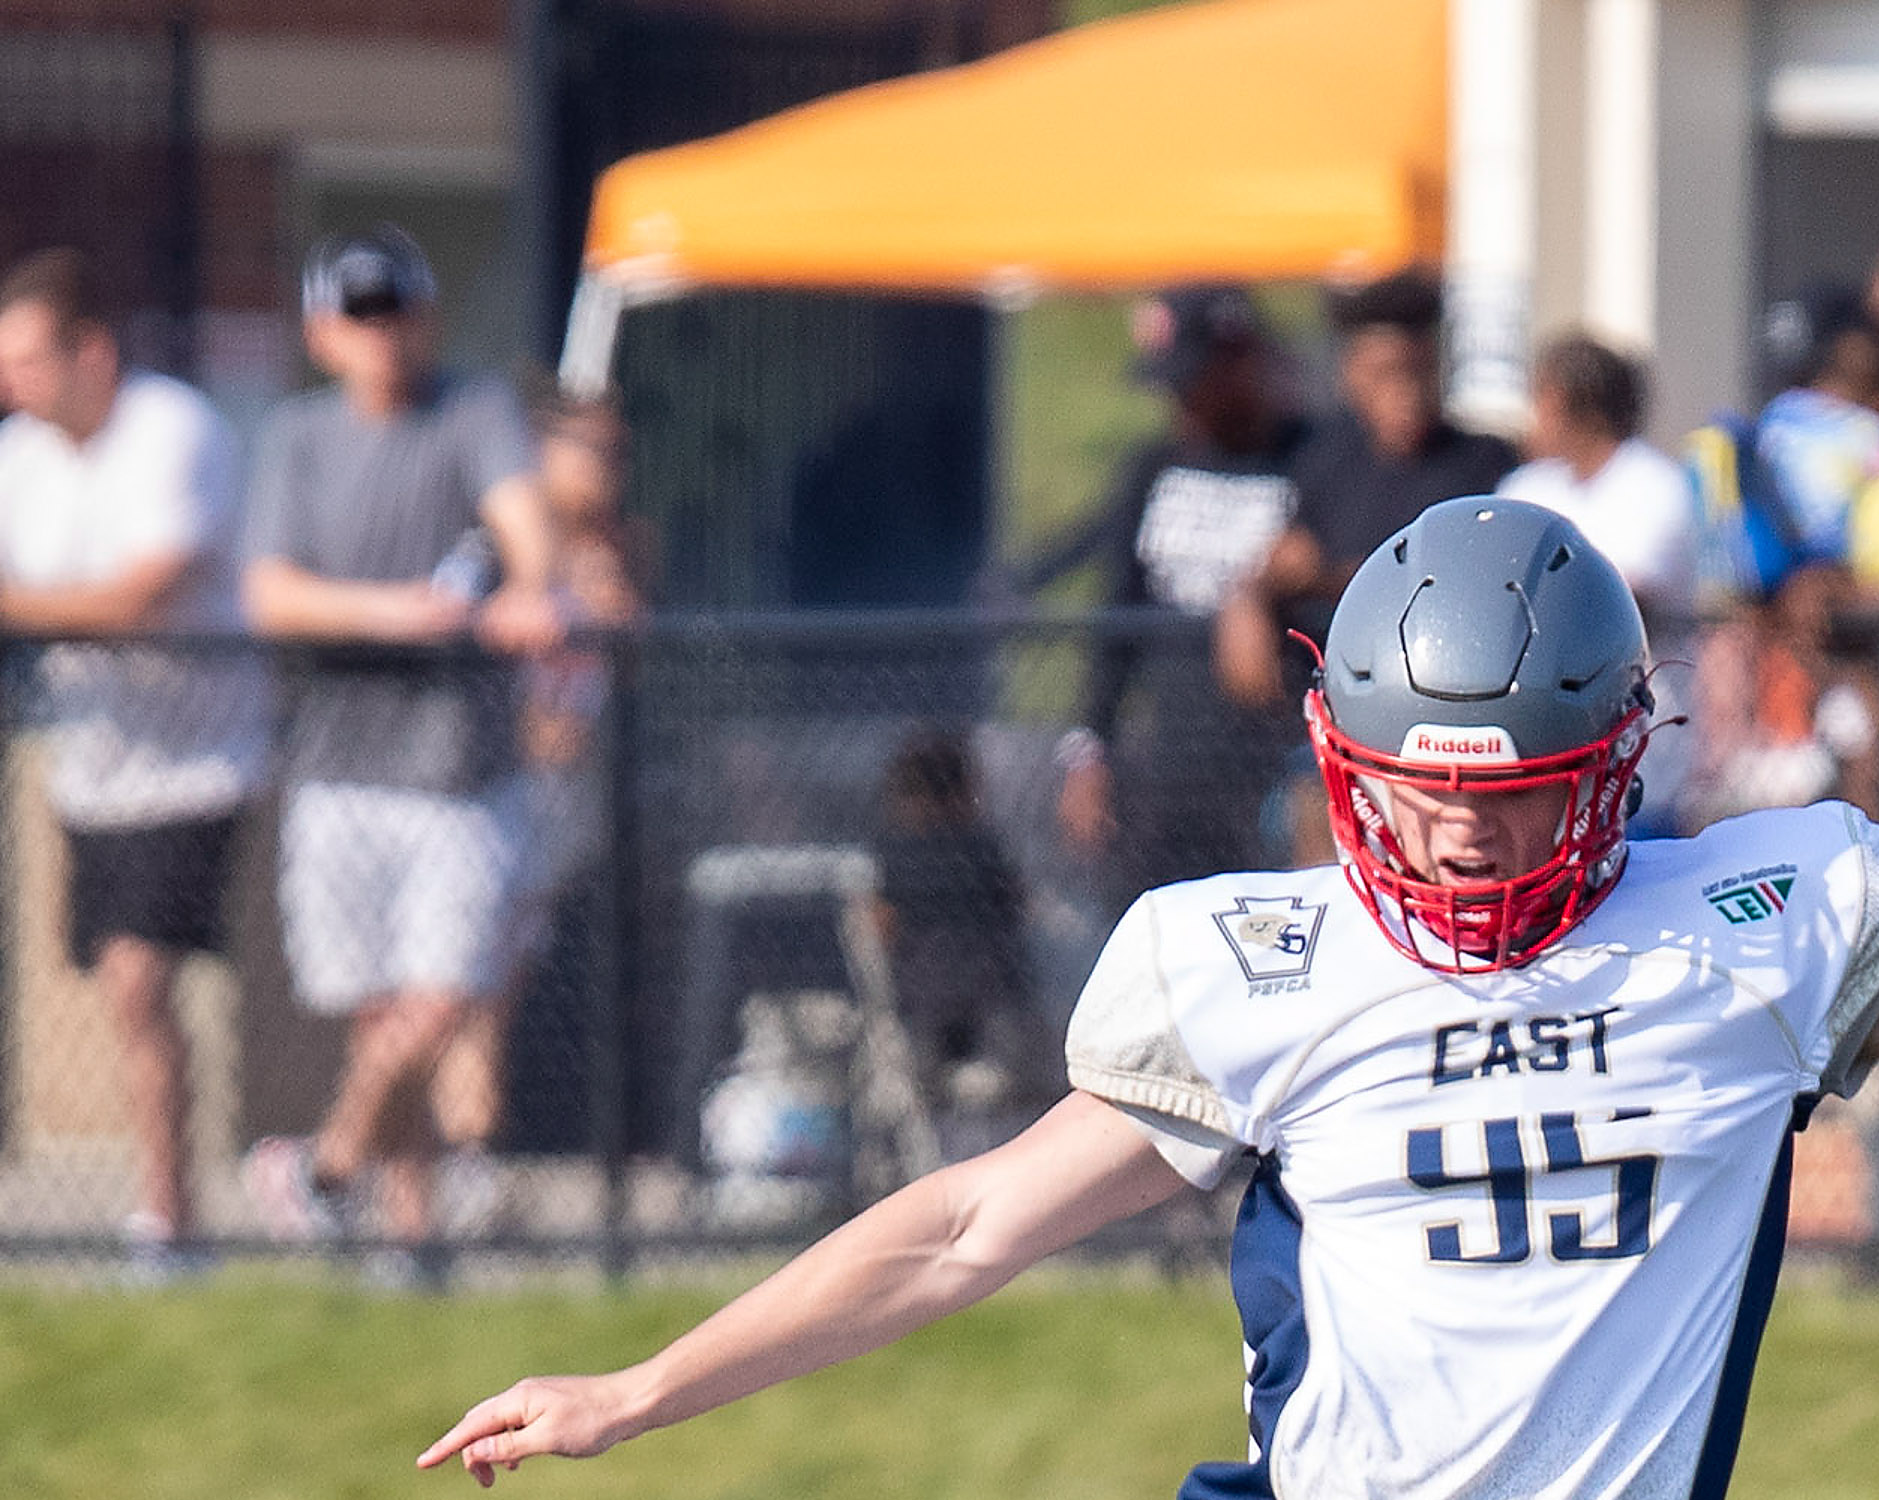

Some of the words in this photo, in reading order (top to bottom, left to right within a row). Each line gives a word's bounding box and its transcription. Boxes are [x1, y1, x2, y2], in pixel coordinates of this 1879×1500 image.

[1417, 734, 1502, 755] Riddell
[1431, 1005, 1622, 1088] EAST
[1405, 1106, 1660, 1264] 95
